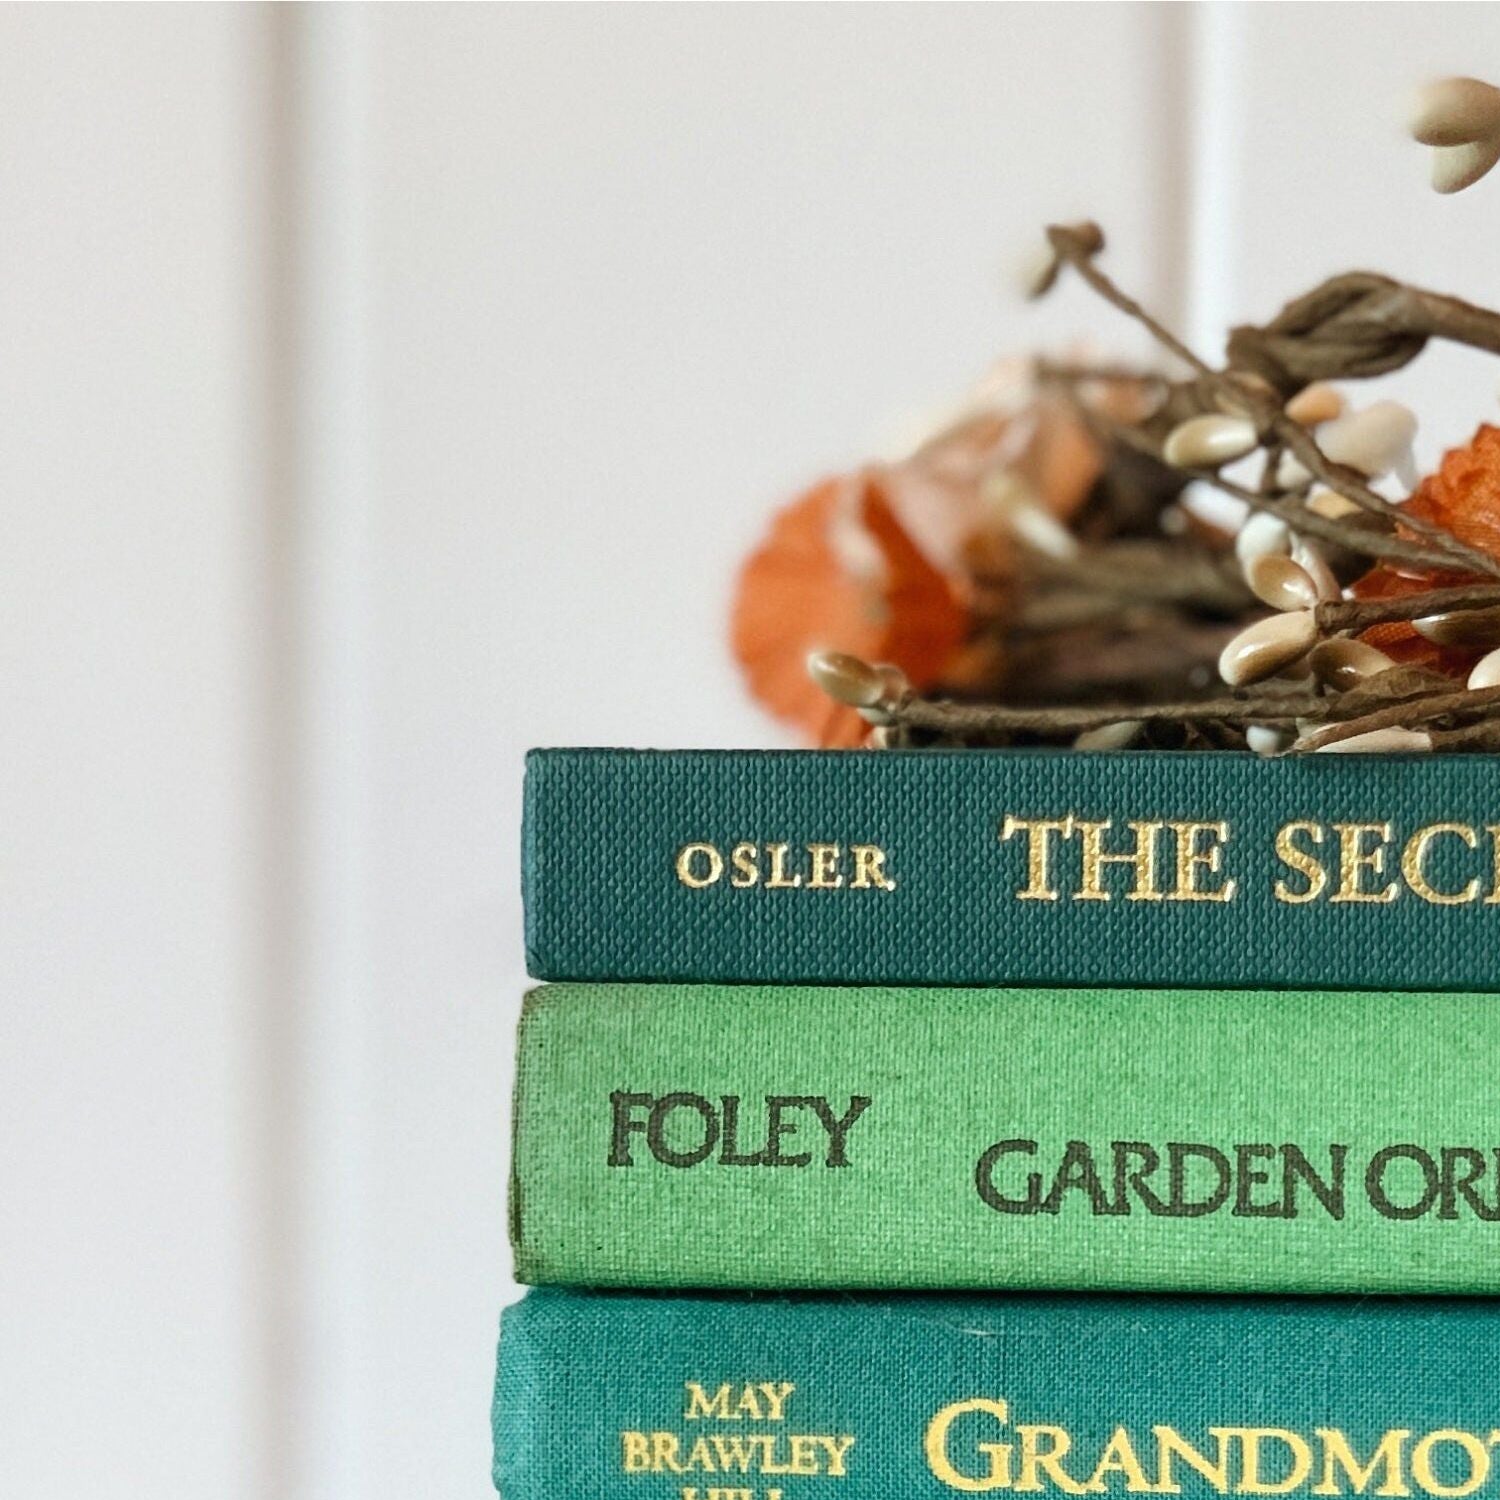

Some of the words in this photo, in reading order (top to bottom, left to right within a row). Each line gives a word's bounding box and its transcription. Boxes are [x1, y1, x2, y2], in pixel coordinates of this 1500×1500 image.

[676, 842, 896, 891] OSLER
[1001, 814, 1236, 903] THE
[606, 1091, 871, 1167] FOLEY
[976, 1139, 1346, 1217] GARDEN
[686, 1383, 794, 1420] MAY
[620, 1435, 854, 1476] BRAWLEY
